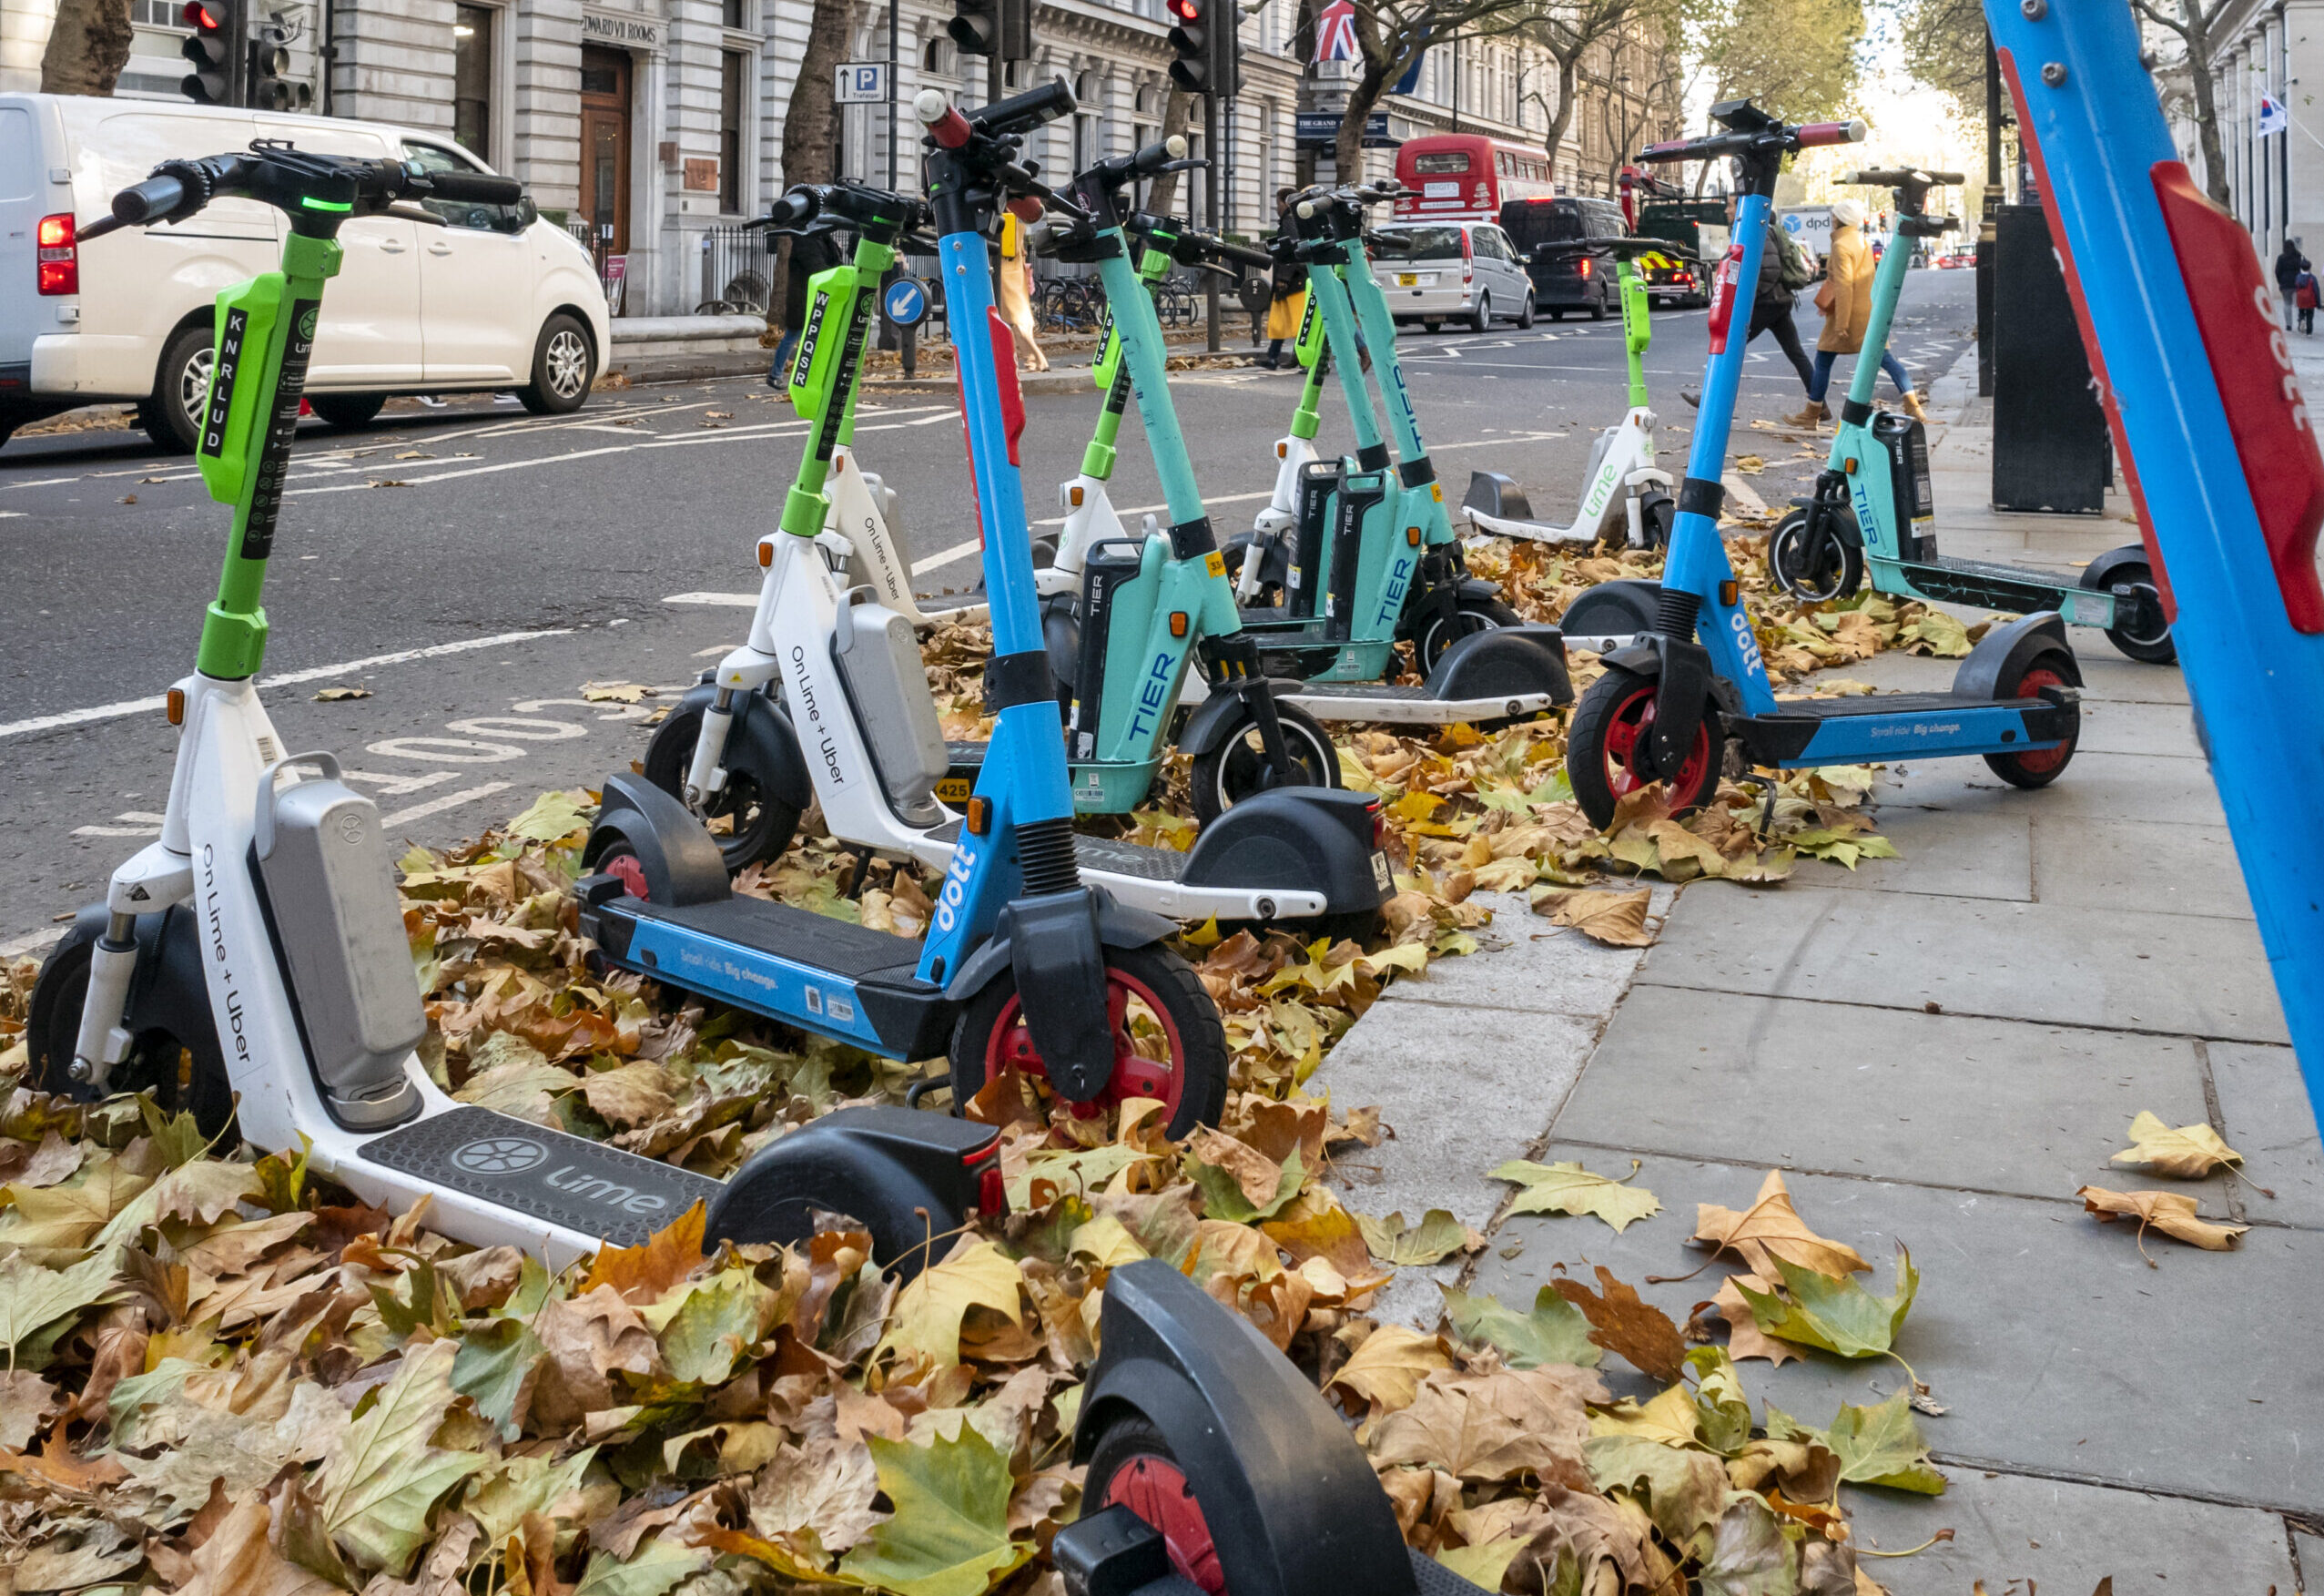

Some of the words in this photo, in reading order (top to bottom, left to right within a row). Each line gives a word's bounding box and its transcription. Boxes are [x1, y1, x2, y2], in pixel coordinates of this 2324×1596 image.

[583, 15, 614, 36] DWARD
[627, 22, 655, 43] ROOMS
[860, 69, 874, 89] P
[1806, 217, 1830, 230] dpd
[1710, 274, 1726, 309] dott
[795, 292, 829, 386] WPPQSR
[1096, 313, 1112, 362] SUSZ
[1300, 292, 1315, 342] UVFYF
[208, 315, 243, 447] KNRLUD
[1895, 437, 1903, 465] TIER
[1308, 490, 1318, 519] TIER
[1585, 464, 1617, 516] Lime
[1855, 483, 1878, 546] TIER
[1344, 504, 1355, 535] TIER
[865, 517, 876, 536] On
[872, 534, 886, 564] Lime
[886, 571, 899, 601] Uber
[1091, 574, 1103, 616] TIER
[1376, 558, 1411, 626] TIER
[1731, 613, 1761, 676] dott
[792, 646, 805, 675] On
[799, 675, 820, 722] Lime
[820, 737, 844, 785] Uber
[1128, 653, 1176, 741] TIER
[1913, 724, 1928, 737] Big
[203, 843, 214, 888] On
[1073, 846, 1143, 863] ime
[939, 843, 976, 931] dott
[208, 891, 226, 962] Lime
[725, 961, 740, 981] Big
[226, 990, 250, 1063] Uber
[546, 1165, 667, 1215] Lime
